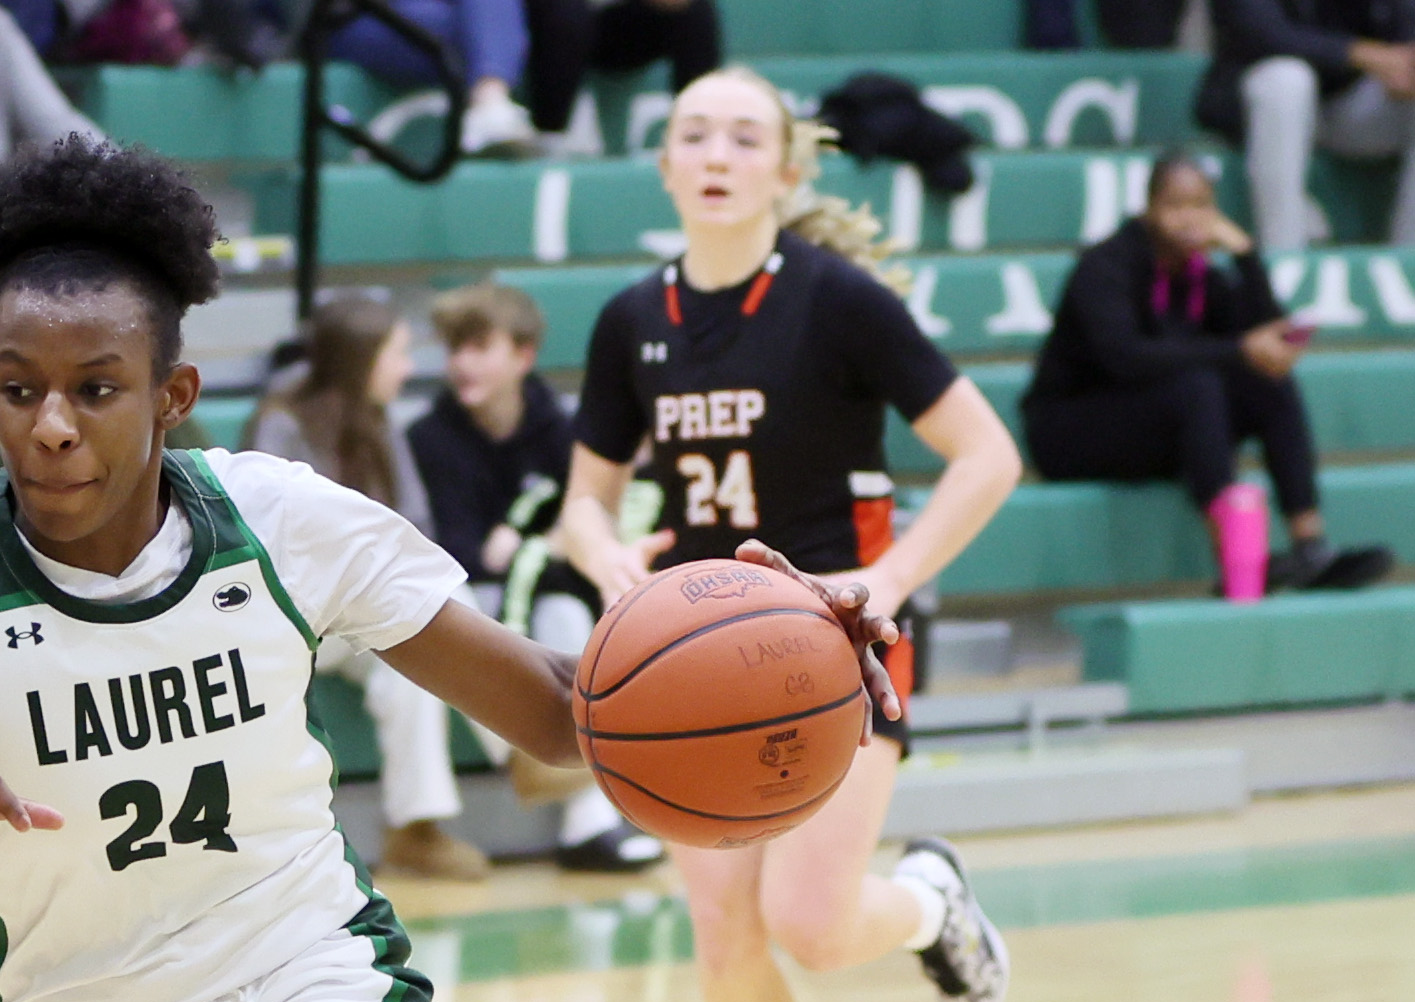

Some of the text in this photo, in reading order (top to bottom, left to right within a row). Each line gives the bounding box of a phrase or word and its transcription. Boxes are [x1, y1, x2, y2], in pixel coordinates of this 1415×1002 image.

[655, 389, 766, 442] PREP
[676, 449, 759, 530] 24
[26, 648, 266, 766] LAUREL
[99, 760, 239, 872] 24
